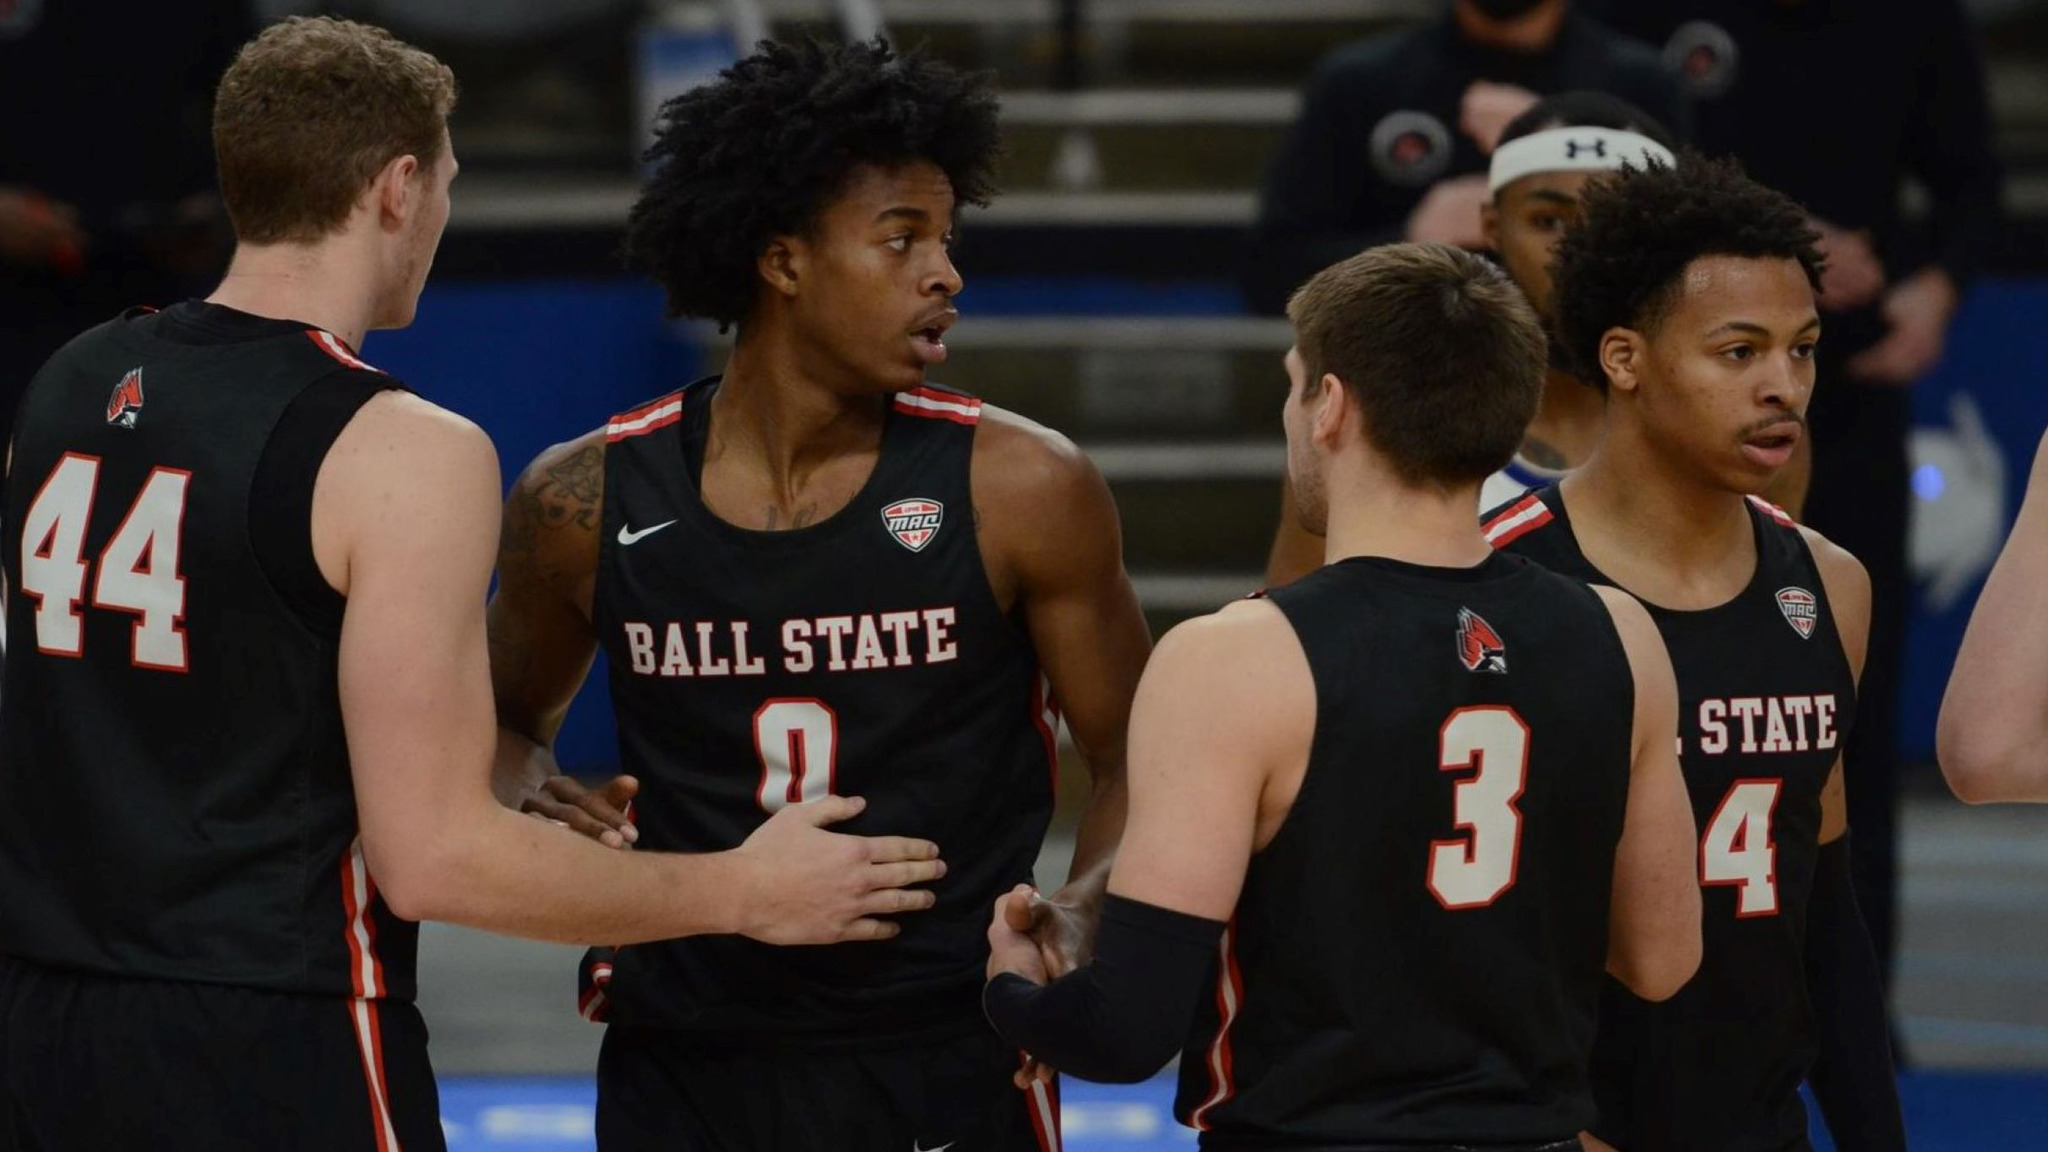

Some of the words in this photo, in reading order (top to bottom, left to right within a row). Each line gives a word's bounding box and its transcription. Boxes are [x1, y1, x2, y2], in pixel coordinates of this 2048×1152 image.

[19, 450, 193, 675] 44
[888, 514, 940, 531] MAC
[624, 620, 766, 677] BALL
[780, 605, 959, 673] STATE
[752, 696, 838, 815] 0
[1699, 693, 1838, 755] STATE
[1425, 703, 1532, 910] 3
[1699, 777, 1783, 919] 4
